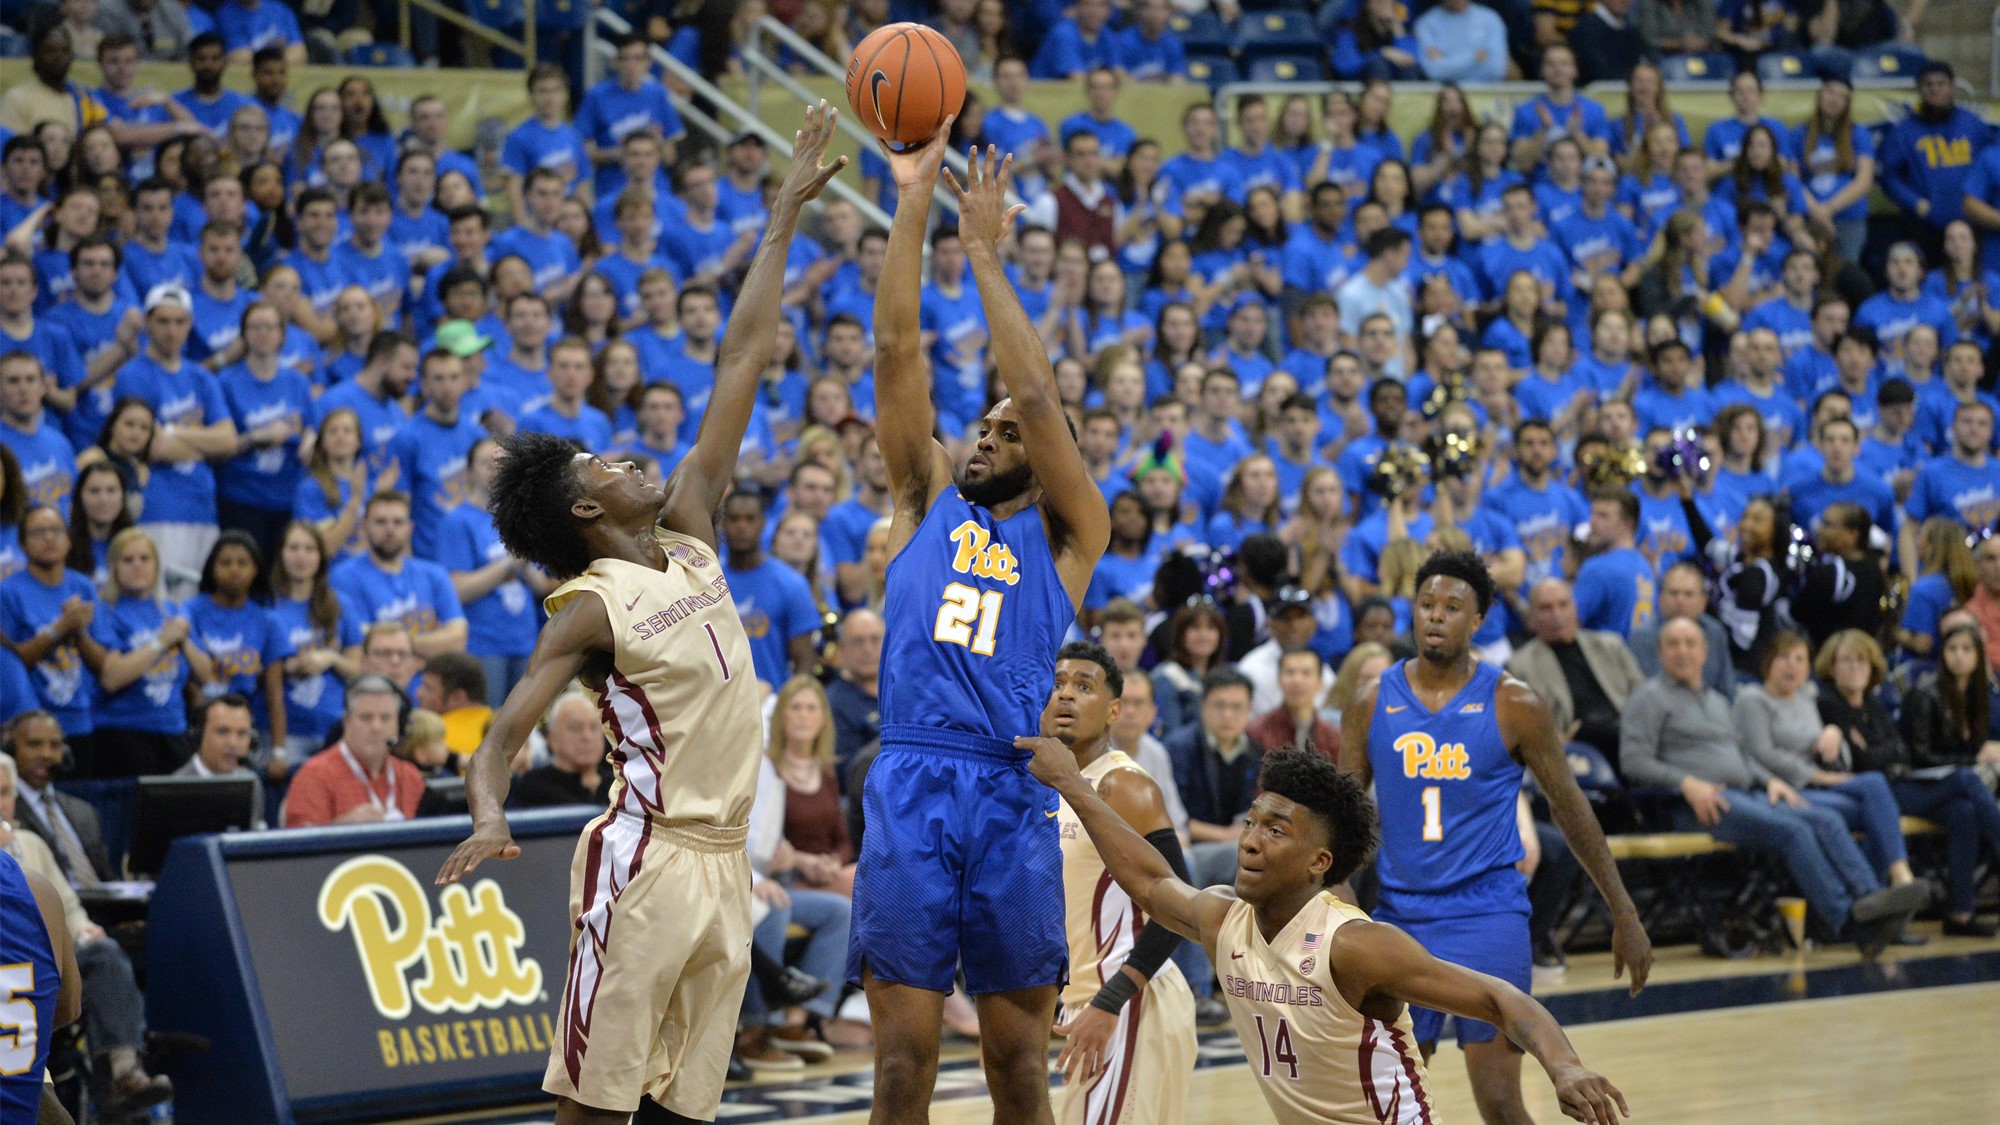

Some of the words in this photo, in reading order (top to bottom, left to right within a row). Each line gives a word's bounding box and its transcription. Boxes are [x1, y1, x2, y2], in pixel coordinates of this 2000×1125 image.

[950, 520, 1020, 585] Pitt
[632, 575, 730, 641] SEMINOLES
[934, 581, 1004, 657] 21
[703, 621, 731, 682] 1
[1393, 731, 1471, 780] Pitt
[1421, 786, 1443, 841] 1
[318, 854, 543, 1019] Pitt
[1226, 974, 1323, 1007] SEMINOLES
[1253, 1013, 1300, 1081] 14
